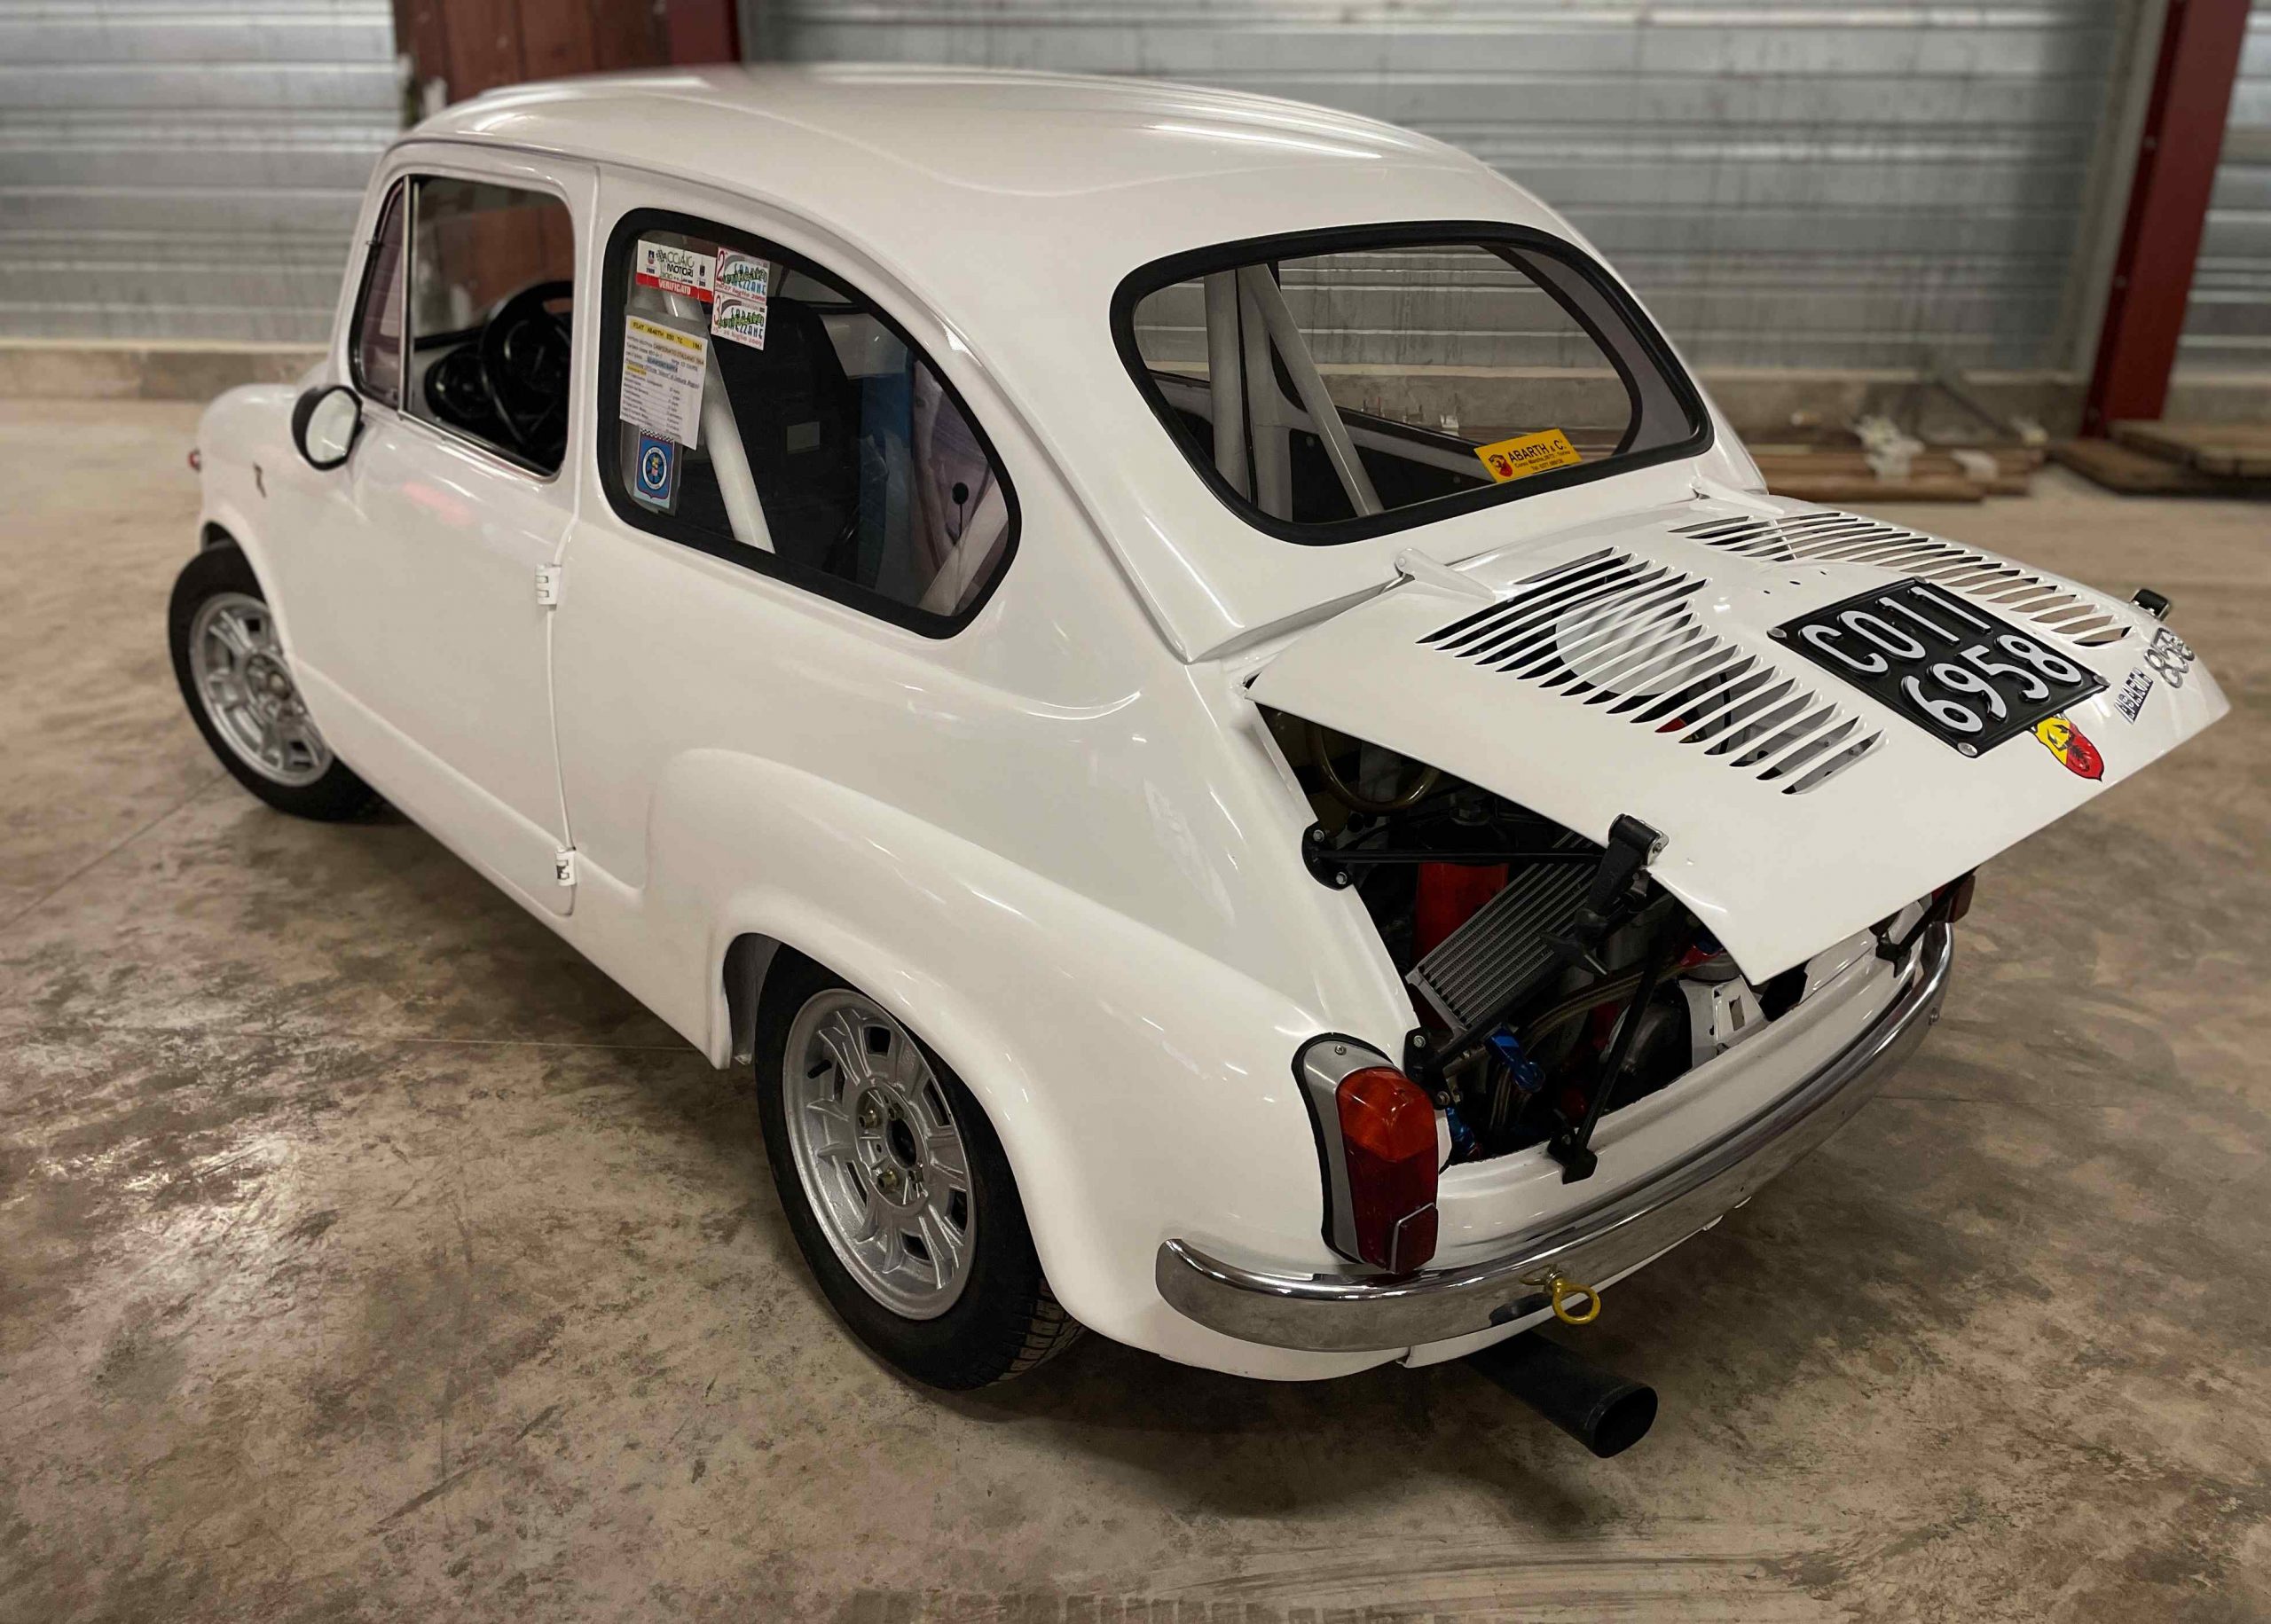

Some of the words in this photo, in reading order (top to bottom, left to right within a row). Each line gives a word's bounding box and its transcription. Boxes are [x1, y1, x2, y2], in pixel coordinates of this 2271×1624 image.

[667, 263, 694, 278] MOTORI
[658, 279, 691, 295] VERIFICATO
[1508, 443, 1550, 462] ABARTH
[1899, 634, 2083, 734] 6958
[2114, 667, 2154, 725] ABARTH
